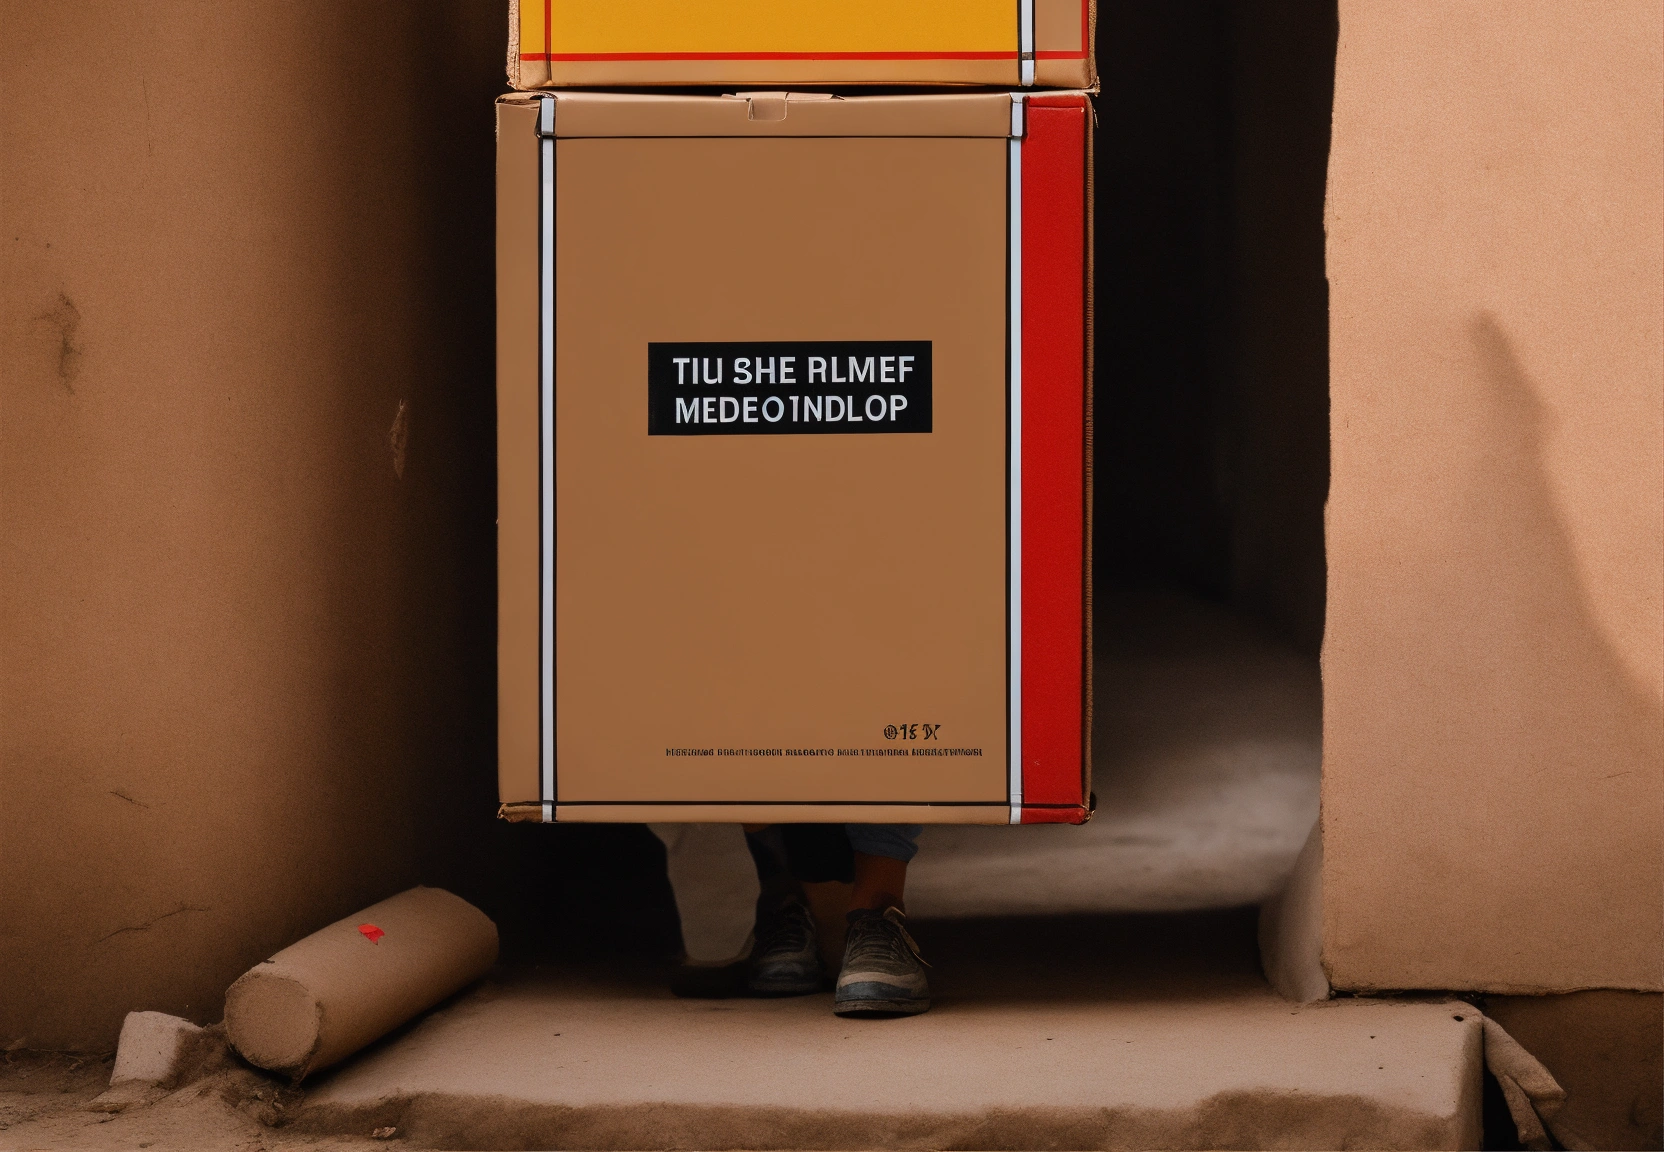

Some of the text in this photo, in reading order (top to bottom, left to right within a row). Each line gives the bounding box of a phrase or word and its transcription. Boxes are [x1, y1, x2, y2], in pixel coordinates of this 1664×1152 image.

[672, 355, 915, 385] TIU SHE RLMEF
